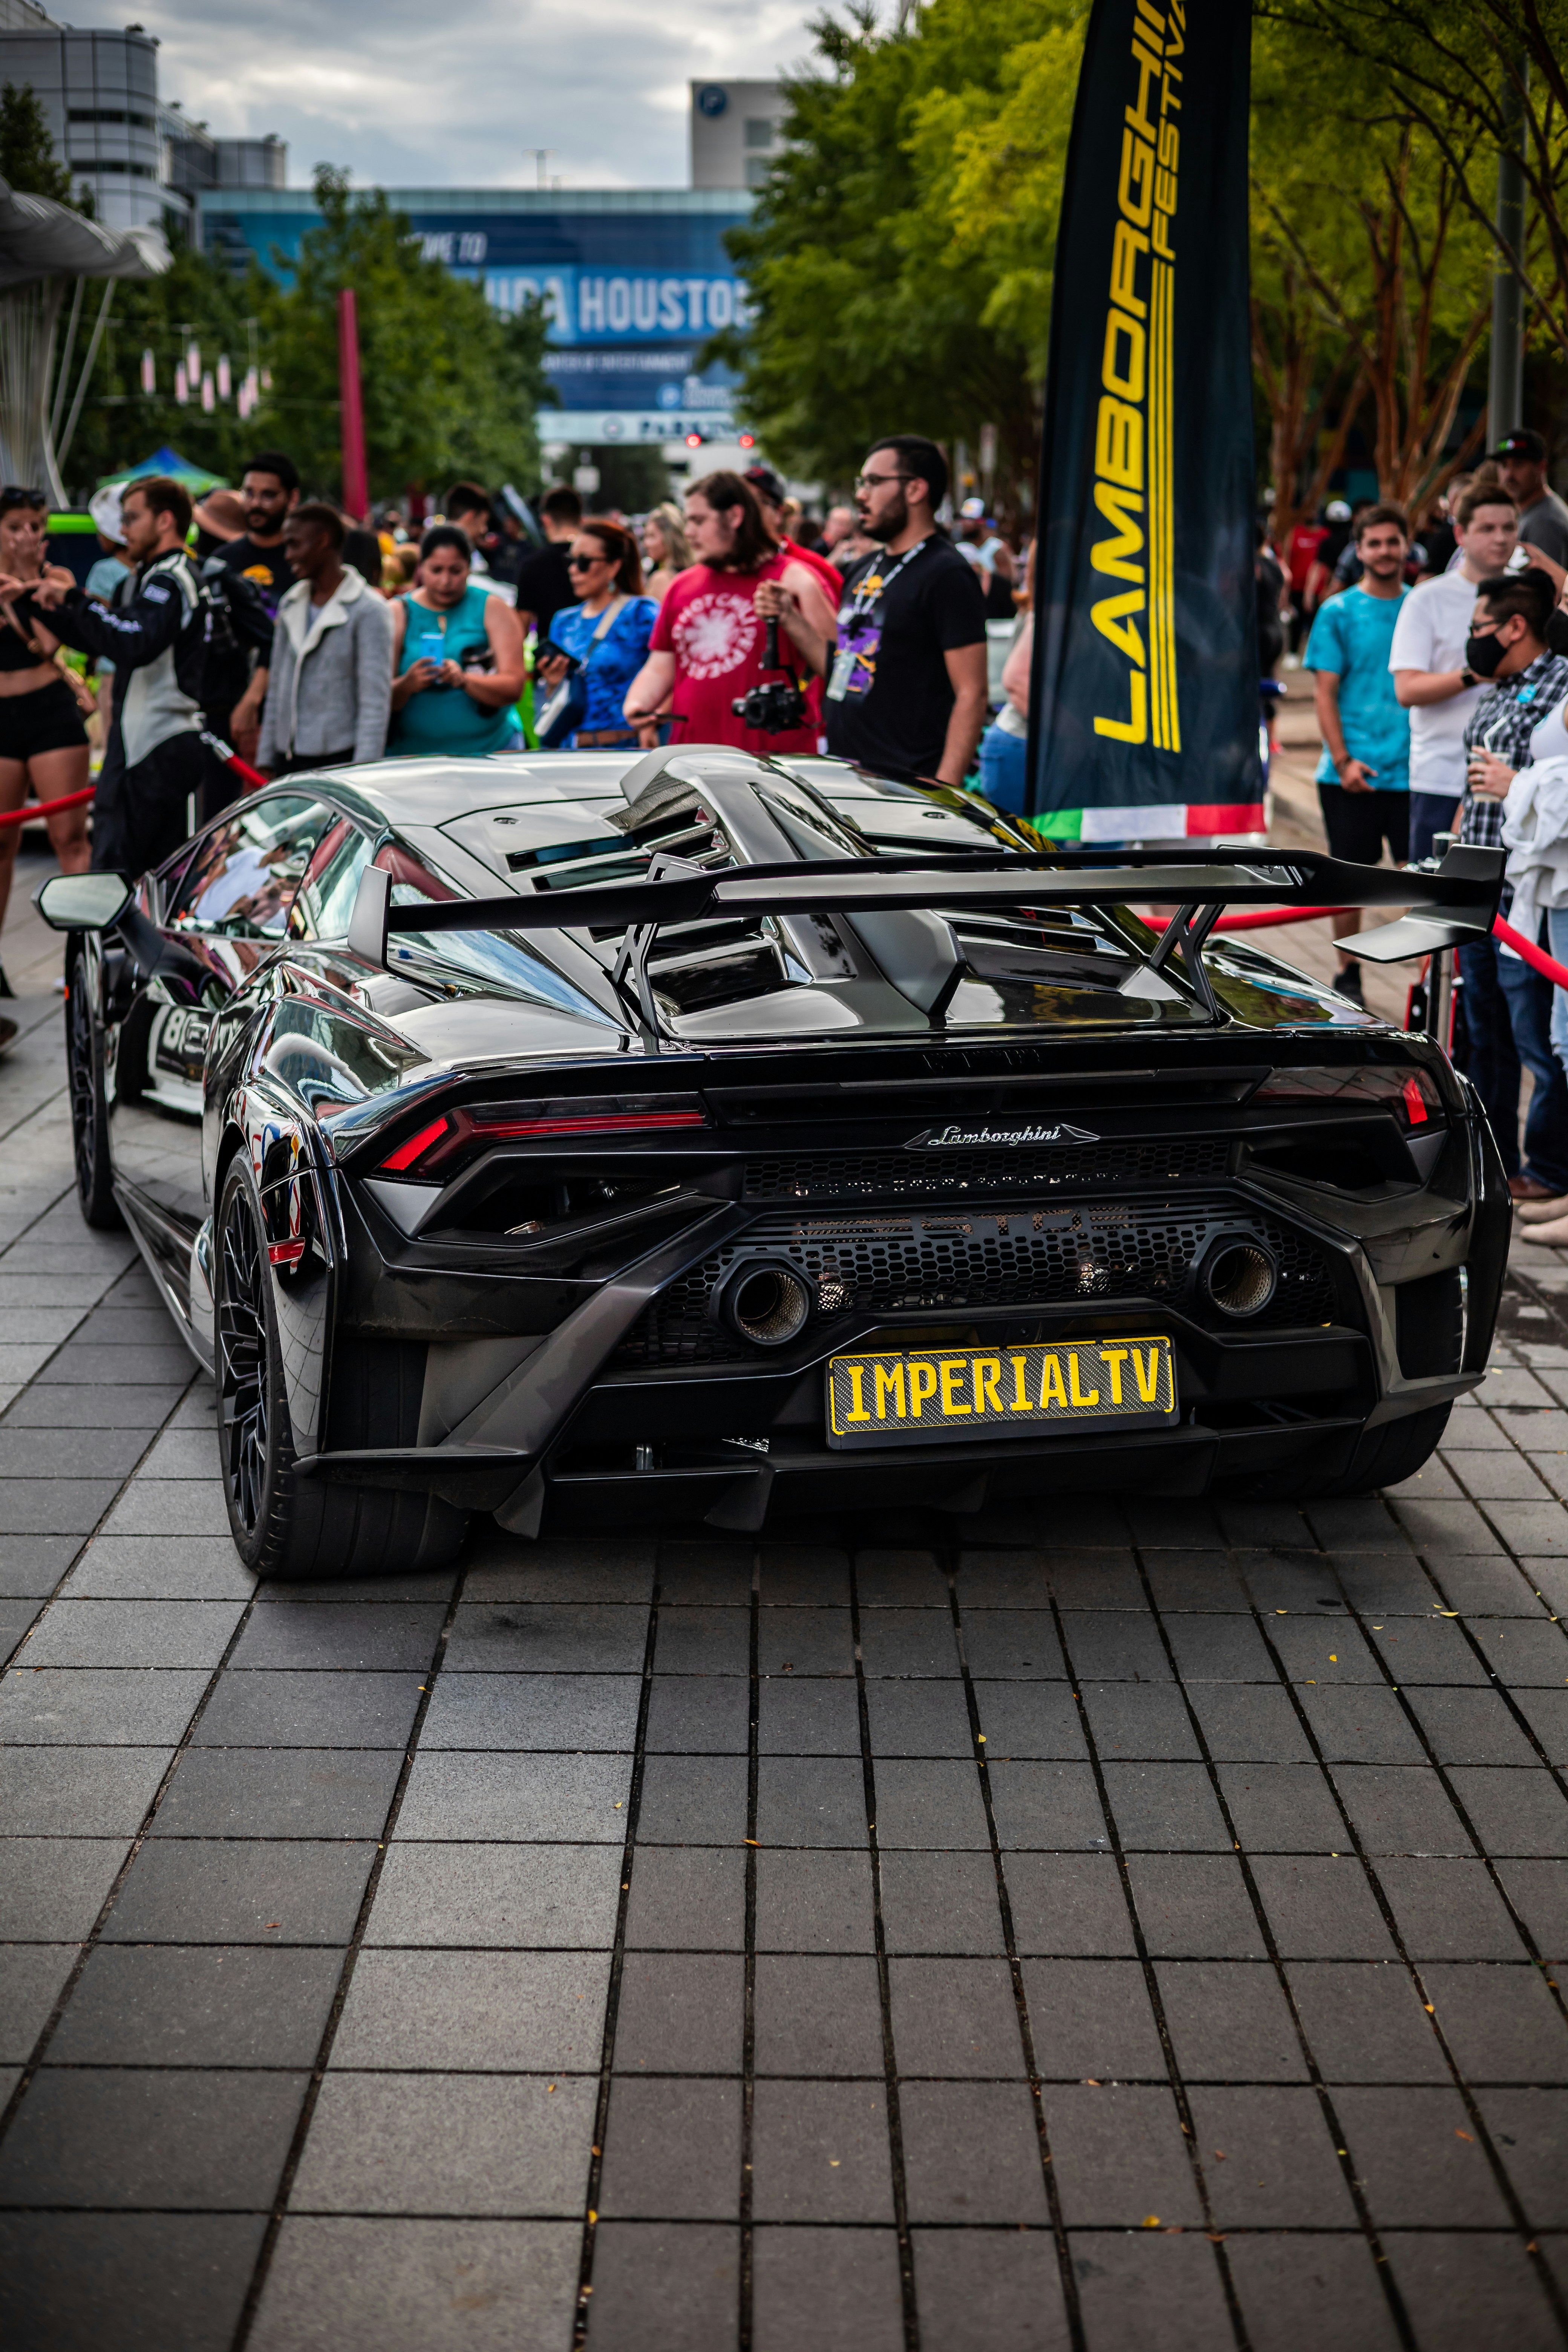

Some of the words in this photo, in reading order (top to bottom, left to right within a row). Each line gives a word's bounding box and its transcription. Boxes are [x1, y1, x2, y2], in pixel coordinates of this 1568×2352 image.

[928, 1125, 1061, 1146] Lamborghini
[920, 1208, 1083, 1239] STO
[847, 1348, 1159, 1422] IMPERIALTV
